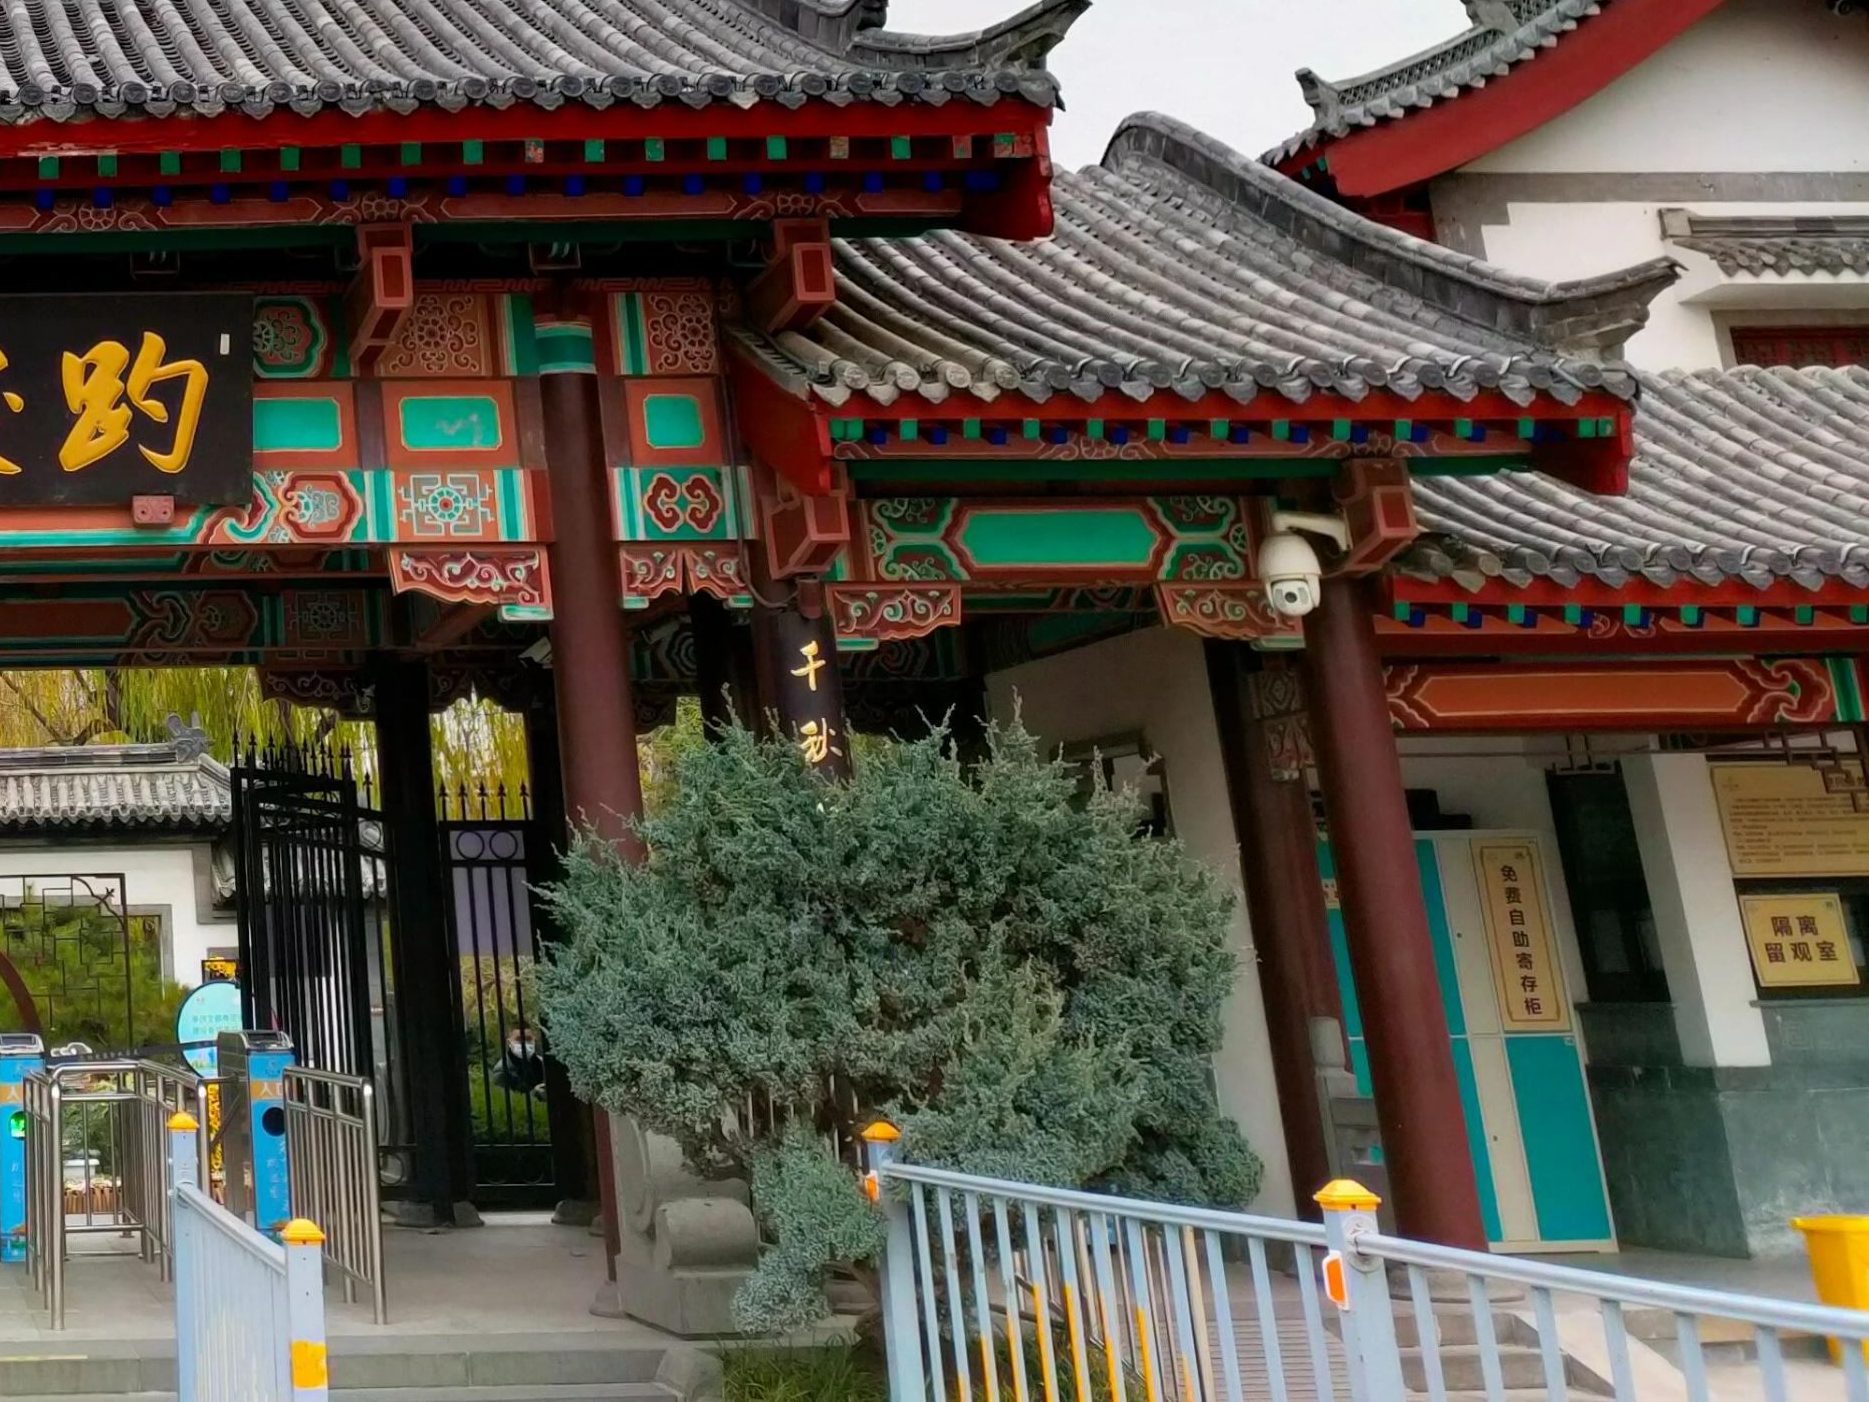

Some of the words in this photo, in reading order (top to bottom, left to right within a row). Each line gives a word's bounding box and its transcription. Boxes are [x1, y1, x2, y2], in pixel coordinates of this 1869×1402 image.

[1771, 915, 1819, 937] 隔离
[1500, 865, 1542, 1016] 免费自助寄存柜
[1764, 940, 1839, 964] 留观室
